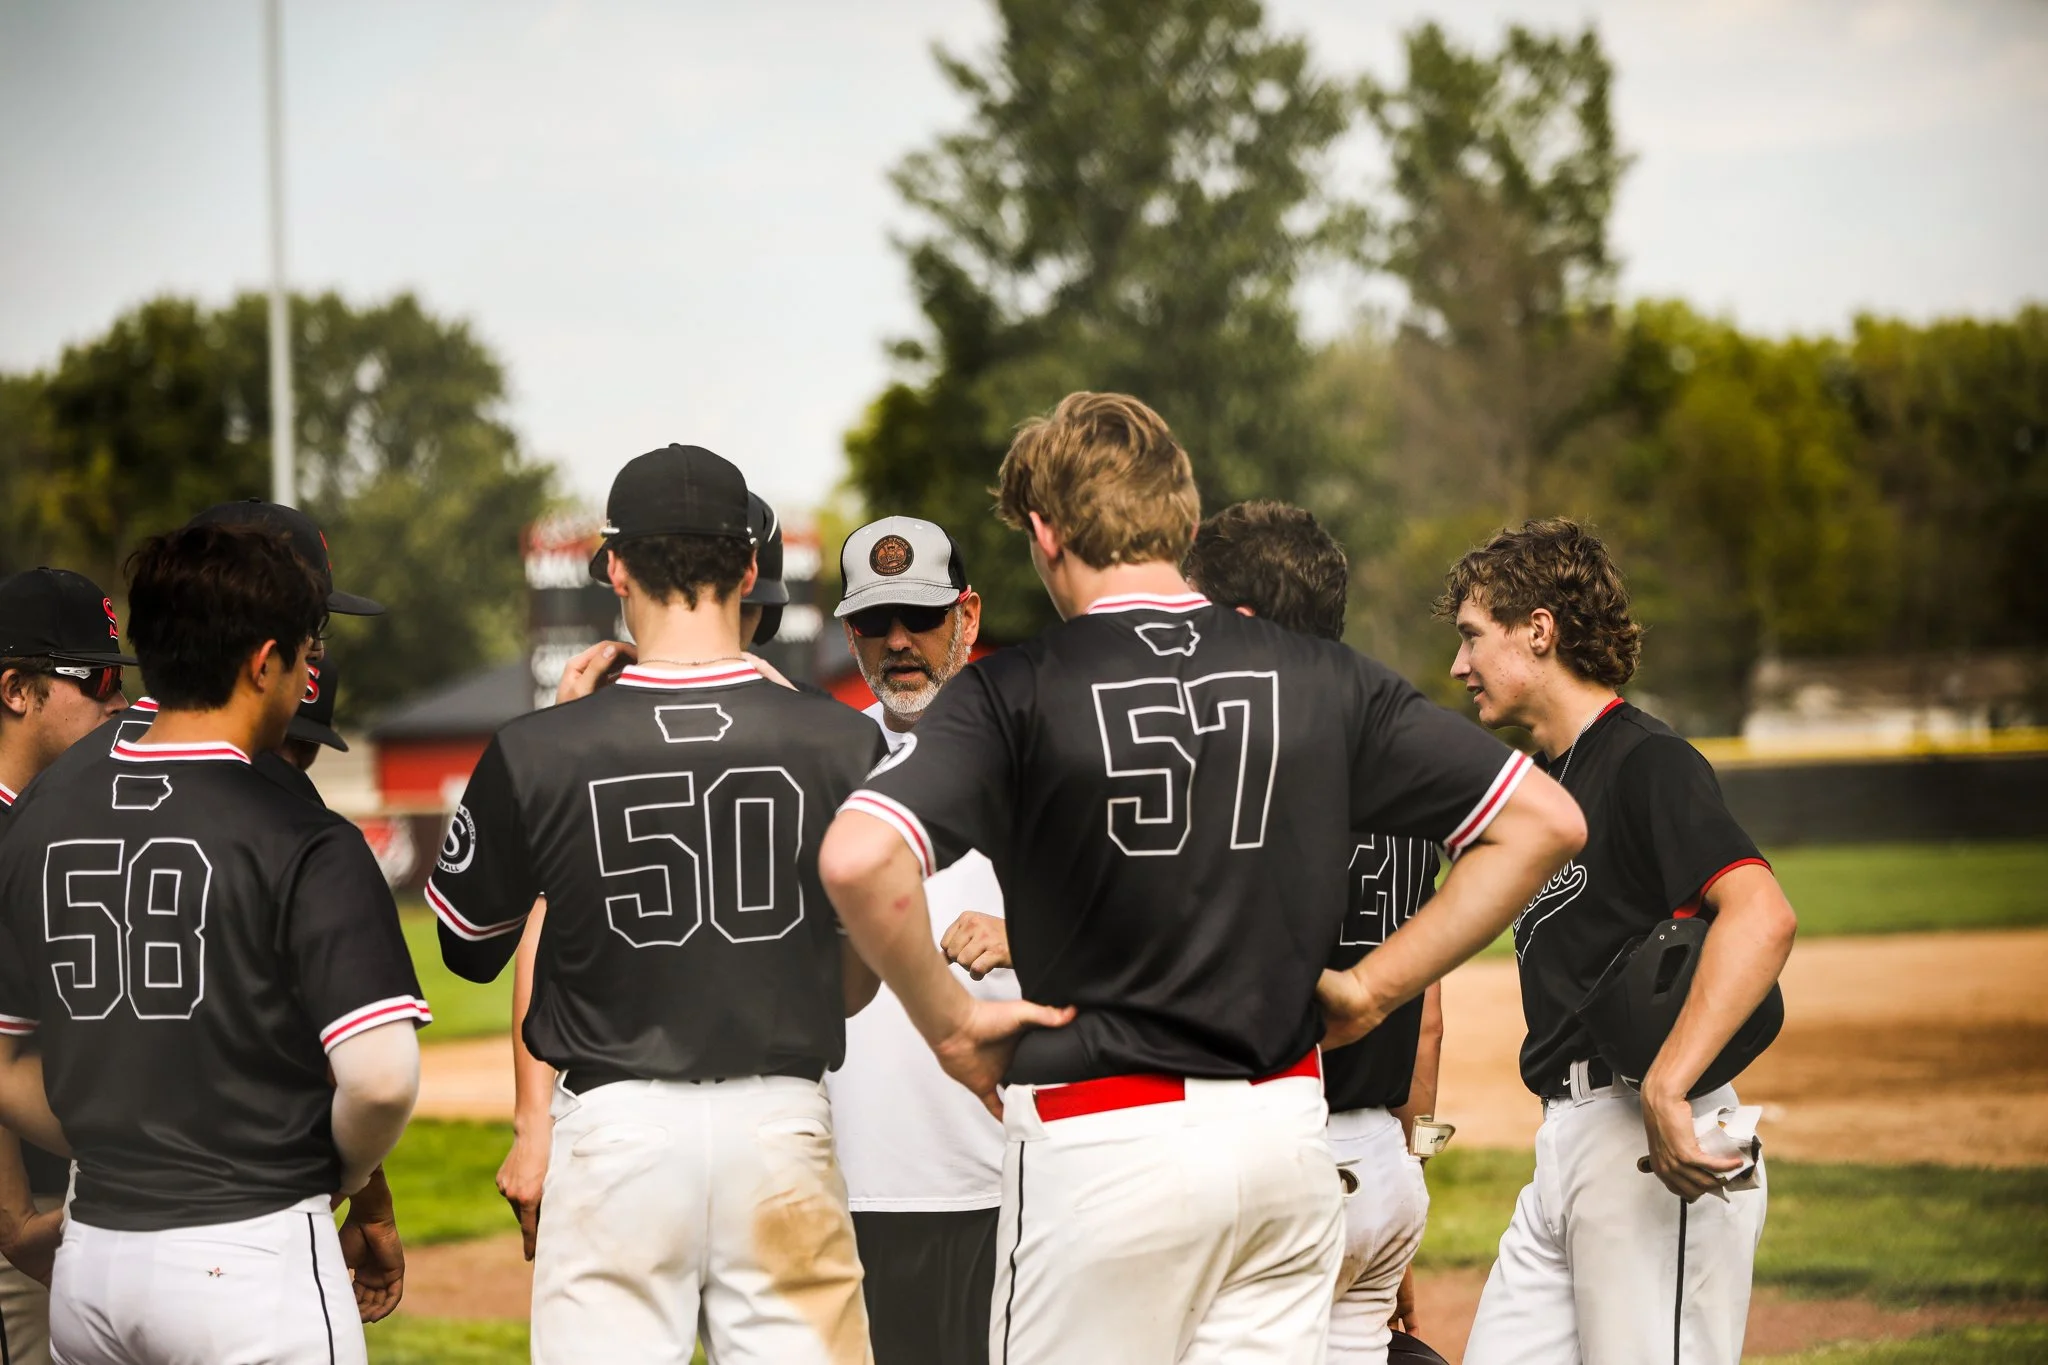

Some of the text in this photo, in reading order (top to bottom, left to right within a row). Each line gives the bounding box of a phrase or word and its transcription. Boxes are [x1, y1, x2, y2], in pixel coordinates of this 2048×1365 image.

[1091, 670, 1280, 857] 57
[43, 838, 213, 1020] 58
[588, 766, 805, 949] 50
